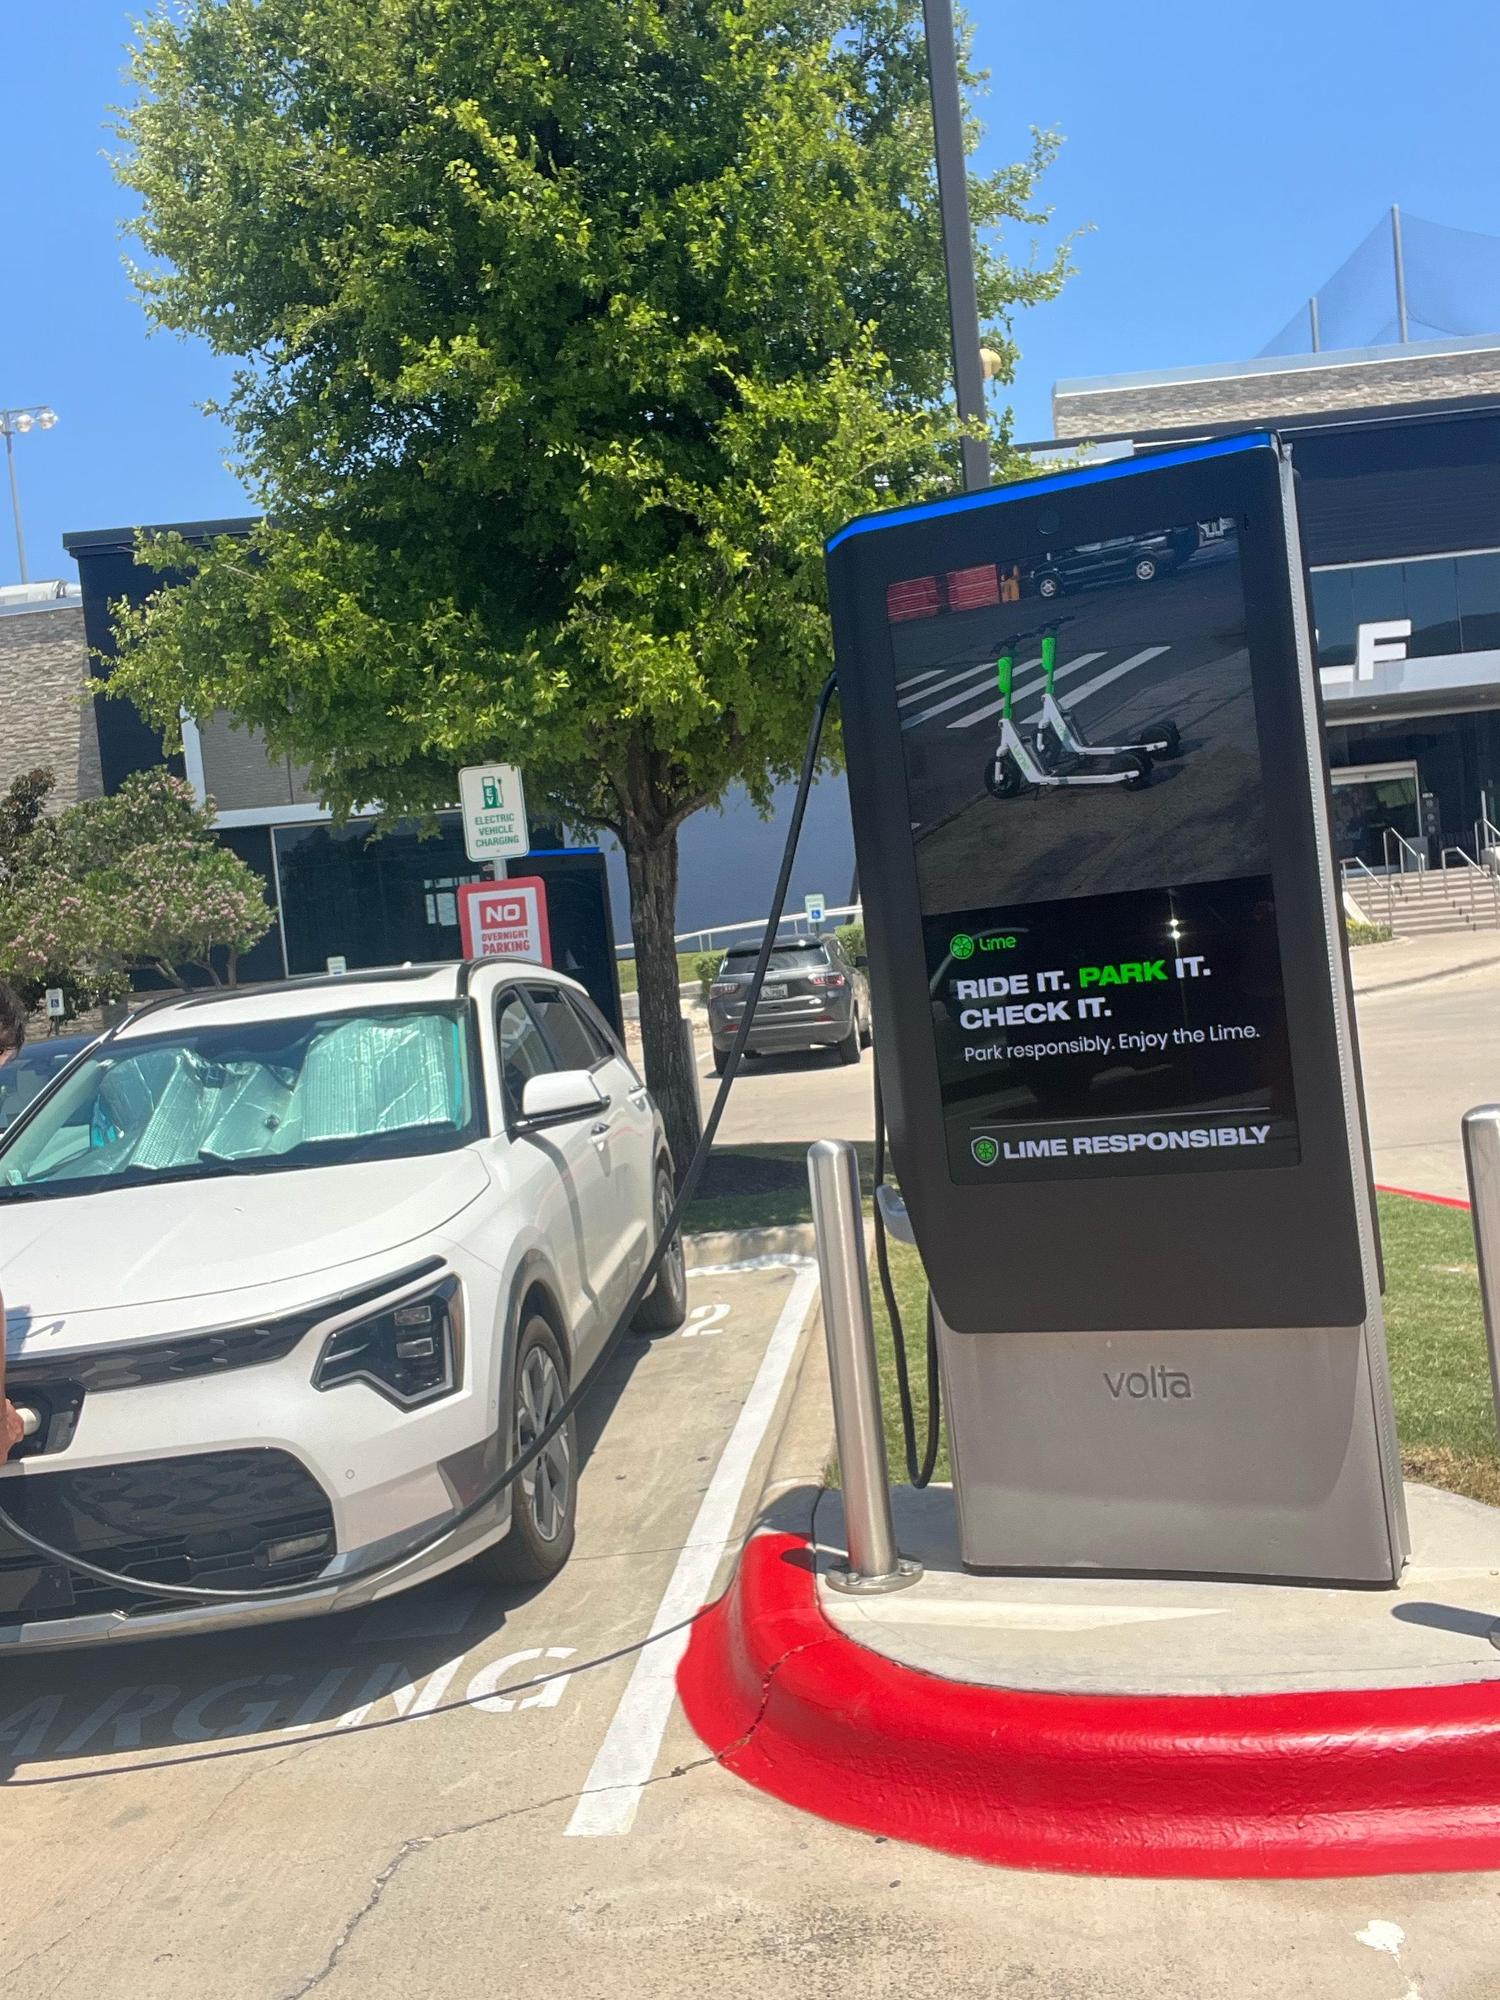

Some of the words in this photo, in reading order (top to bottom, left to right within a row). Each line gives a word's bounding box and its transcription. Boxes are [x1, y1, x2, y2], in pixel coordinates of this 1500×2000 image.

[475, 813, 514, 826] ELECTRIC
[478, 824, 514, 836] VEHICLE
[475, 835, 519, 848] CHARGING
[486, 904, 520, 923] NO
[481, 930, 528, 942] OVERNIGHT
[979, 936, 1016, 951] Lime
[483, 940, 530, 954] PARKING
[957, 973, 1030, 1000] RIDE
[1036, 970, 1071, 993] IT.
[1079, 959, 1169, 988] PARK
[1175, 955, 1212, 978] IT.
[960, 1000, 1071, 1030] CHECK
[1077, 996, 1112, 1019] IT.
[964, 1044, 1003, 1062] Park
[1006, 1035, 1116, 1061] responsibly.
[1118, 1030, 1169, 1052] Enjoy
[1172, 1027, 1205, 1044] the
[1209, 1024, 1261, 1042] Lime.
[1003, 1138, 1069, 1160] LIME
[1073, 1125, 1271, 1155] RESPONSIBLY
[681, 1303, 731, 1337] 2
[1103, 1365, 1192, 1399] volta
